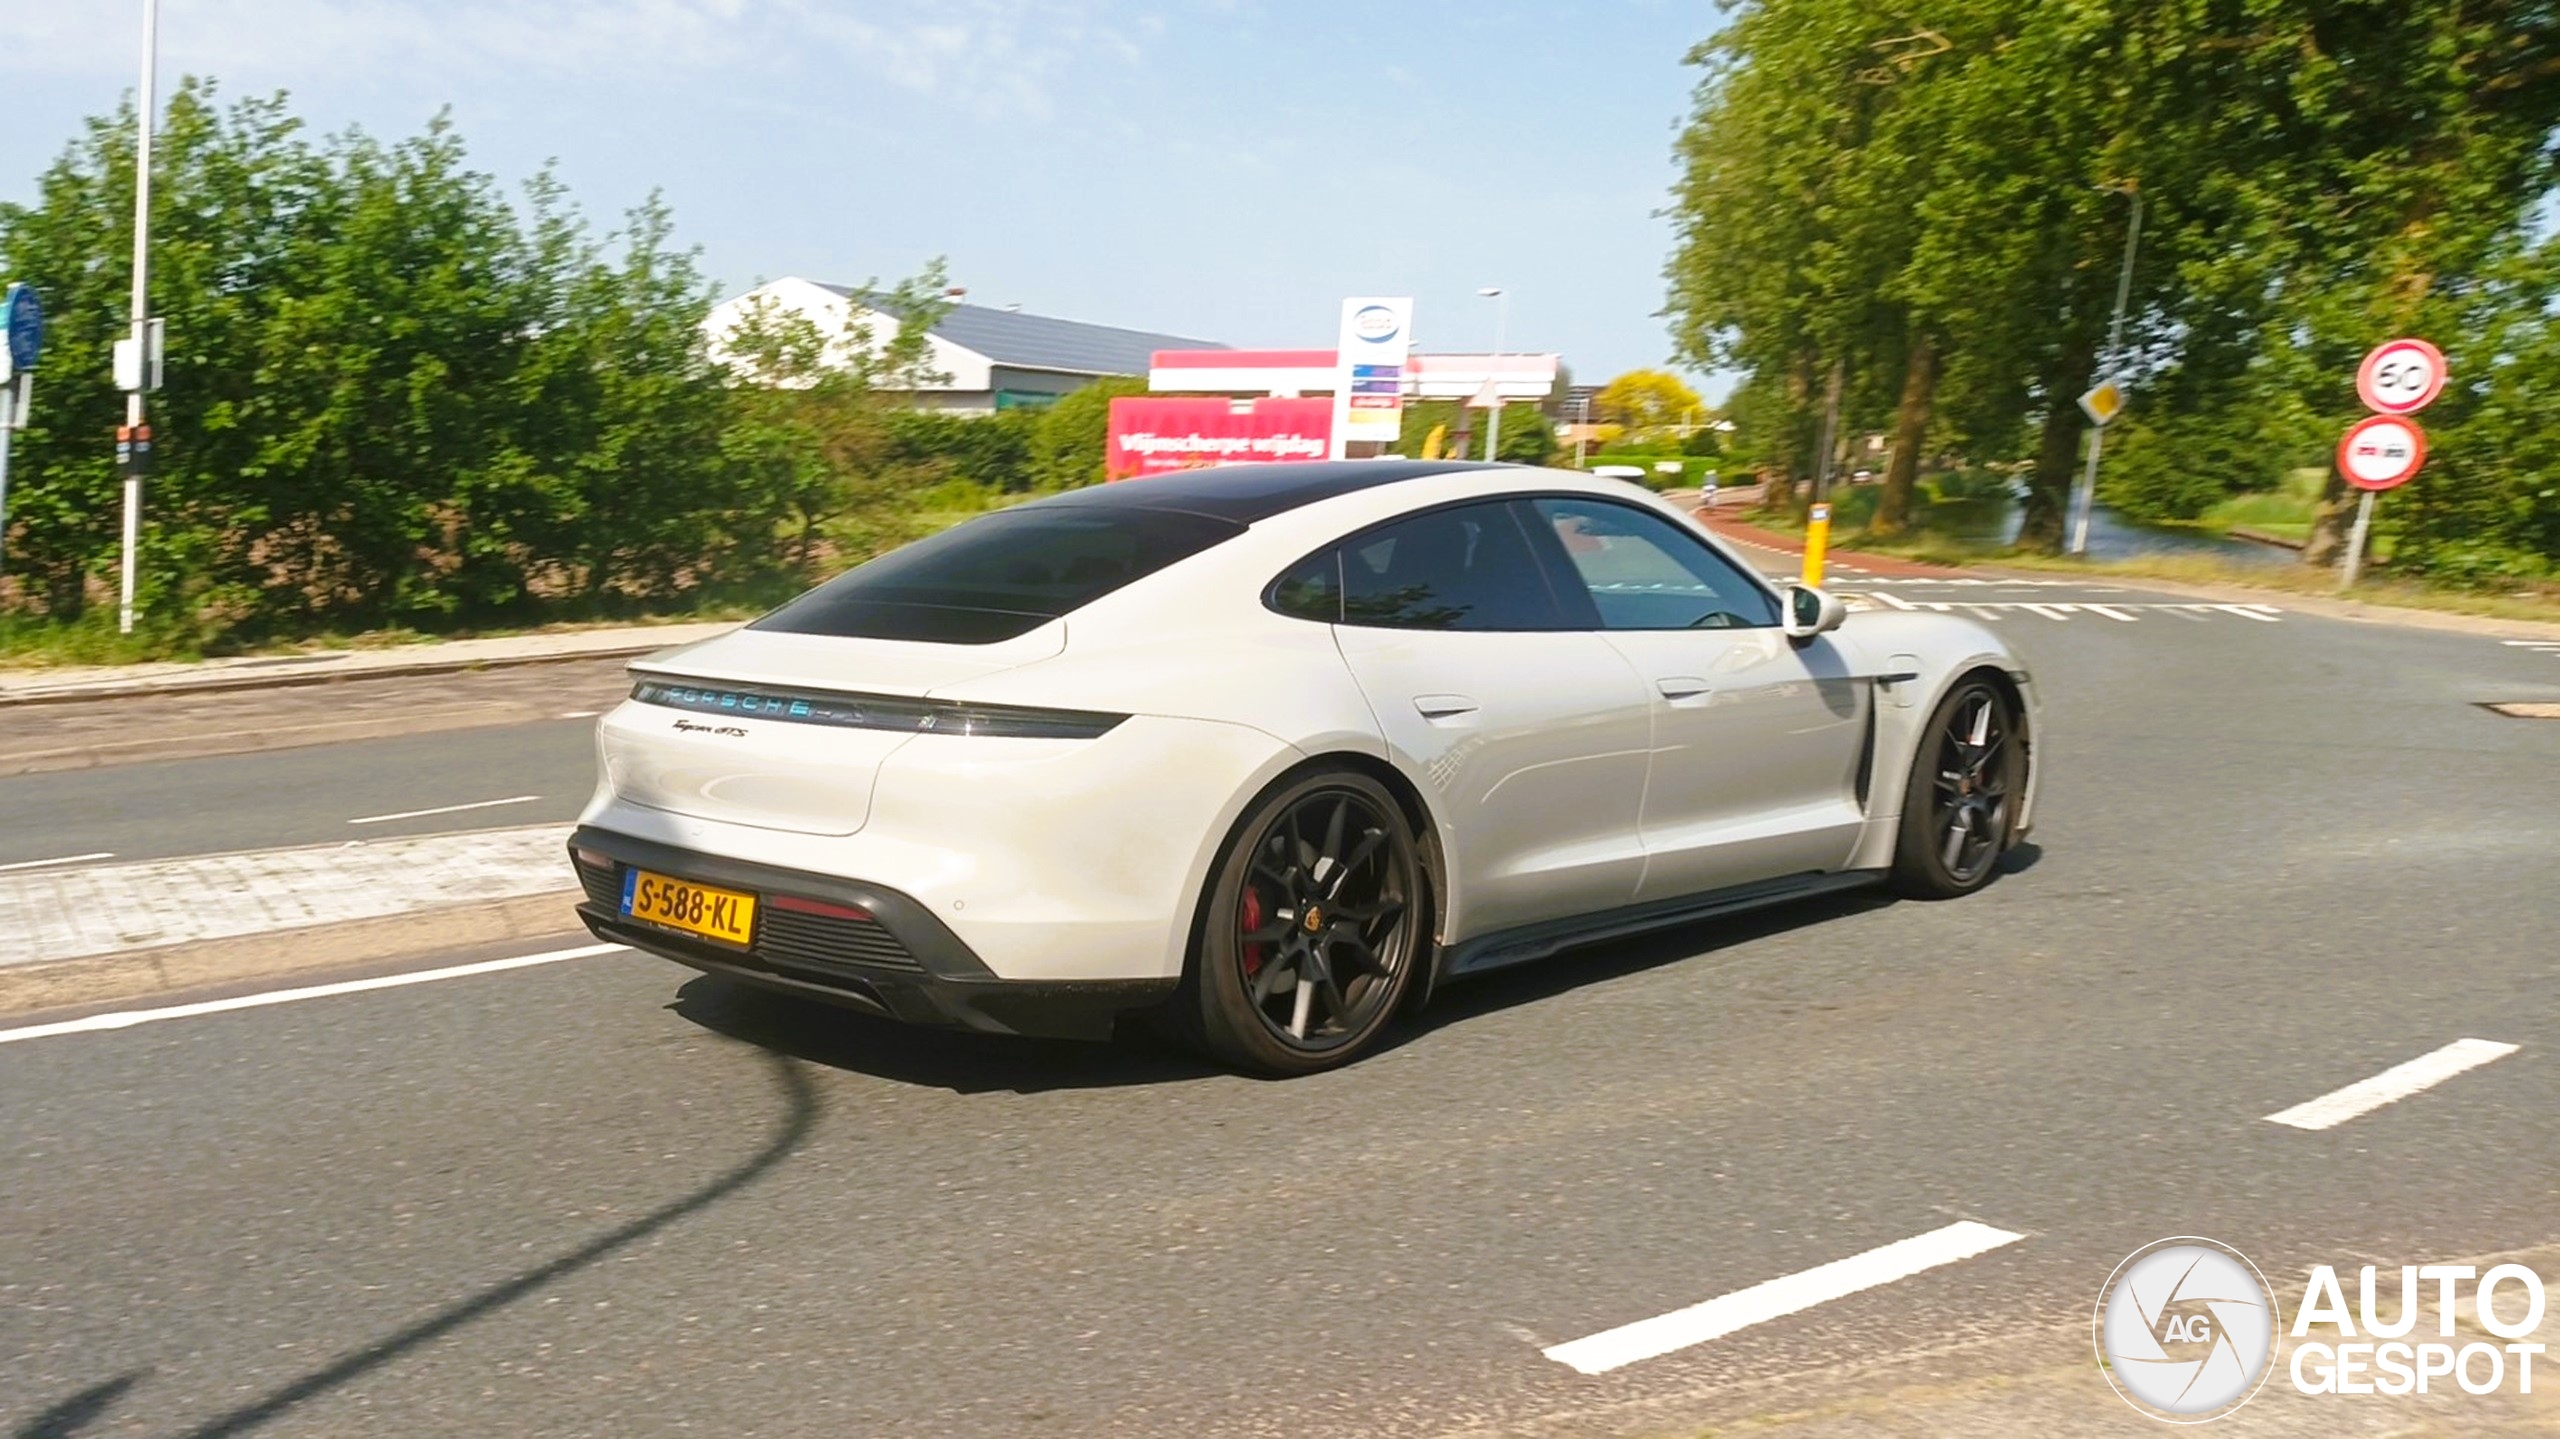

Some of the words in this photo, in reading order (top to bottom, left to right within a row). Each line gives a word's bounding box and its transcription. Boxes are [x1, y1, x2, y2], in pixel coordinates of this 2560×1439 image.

[2378, 362, 2424, 391] 60
[668, 687, 810, 716] PORSCHE
[714, 726, 749, 737] GTS
[638, 879, 742, 935] S-588-KL
